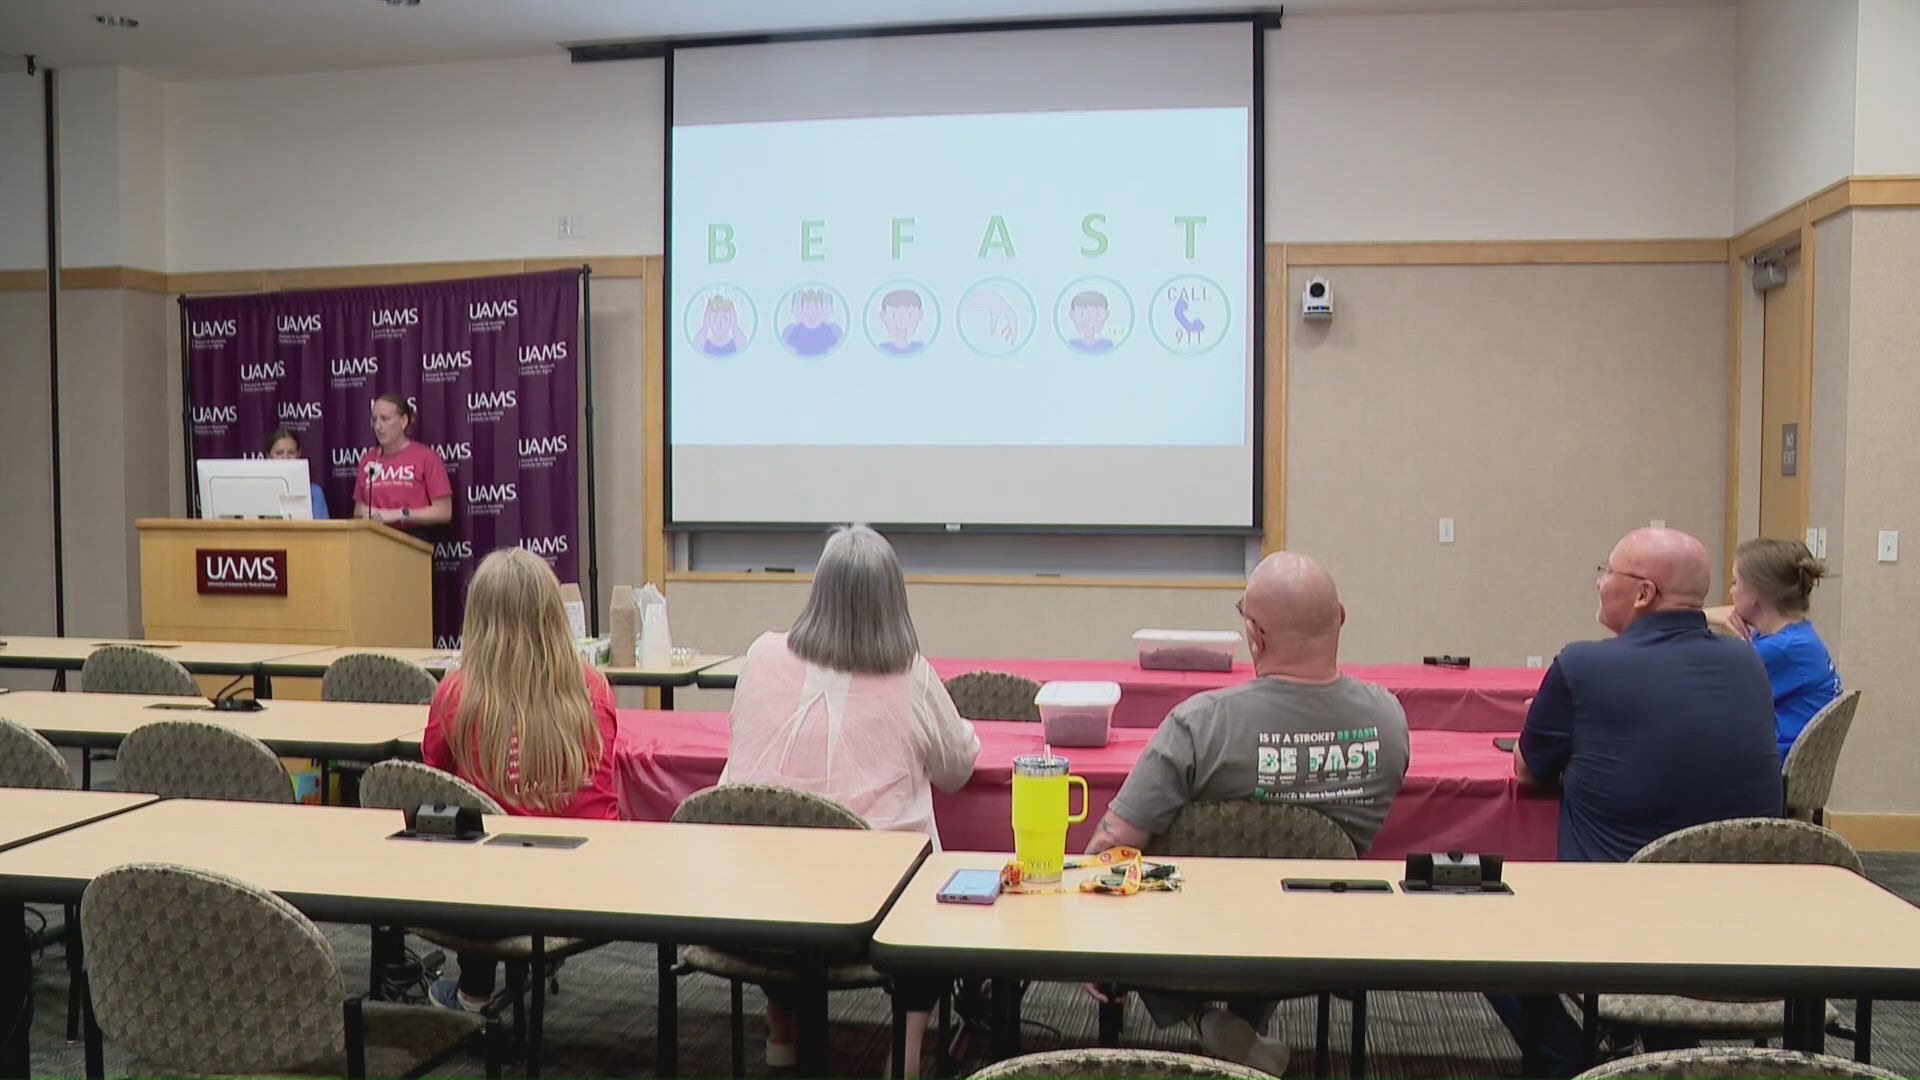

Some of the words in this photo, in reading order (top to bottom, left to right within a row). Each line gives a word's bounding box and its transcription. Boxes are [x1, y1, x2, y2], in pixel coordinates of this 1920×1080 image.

[708, 223, 736, 264] B
[801, 220, 825, 261] E
[891, 217, 915, 260] F
[978, 215, 1016, 259] A
[1080, 213, 1109, 257] S
[1174, 215, 1207, 259] T
[1167, 286, 1212, 302] CALL
[372, 308, 418, 327] UAMS
[469, 300, 518, 319] UAMS
[193, 319, 236, 337] UAMS
[277, 314, 321, 332] UAMS
[1175, 329, 1201, 345] 911
[422, 350, 472, 370] UAMS
[518, 341, 567, 363] UAMS
[241, 360, 285, 380] UAMS
[331, 357, 378, 376] UAMS
[467, 390, 517, 410] UAMS
[193, 406, 237, 423] UAMS
[277, 402, 322, 419] UAMS
[518, 434, 568, 455] UAMS
[1785, 433, 1794, 447] NO
[332, 448, 372, 466] UAM
[431, 442, 471, 461] AMS
[1784, 451, 1795, 464] EXIT
[467, 483, 517, 502] UAMS
[434, 541, 473, 559] AMS
[206, 556, 276, 580] UAMS
[1259, 733, 1269, 743] IS
[1272, 733, 1280, 743] IT
[1283, 733, 1291, 743] A
[1294, 732, 1335, 743] STROKE?
[1258, 746, 1297, 773] BE
[1308, 741, 1379, 772] FAST
[1030, 860, 1050, 868] YETI
